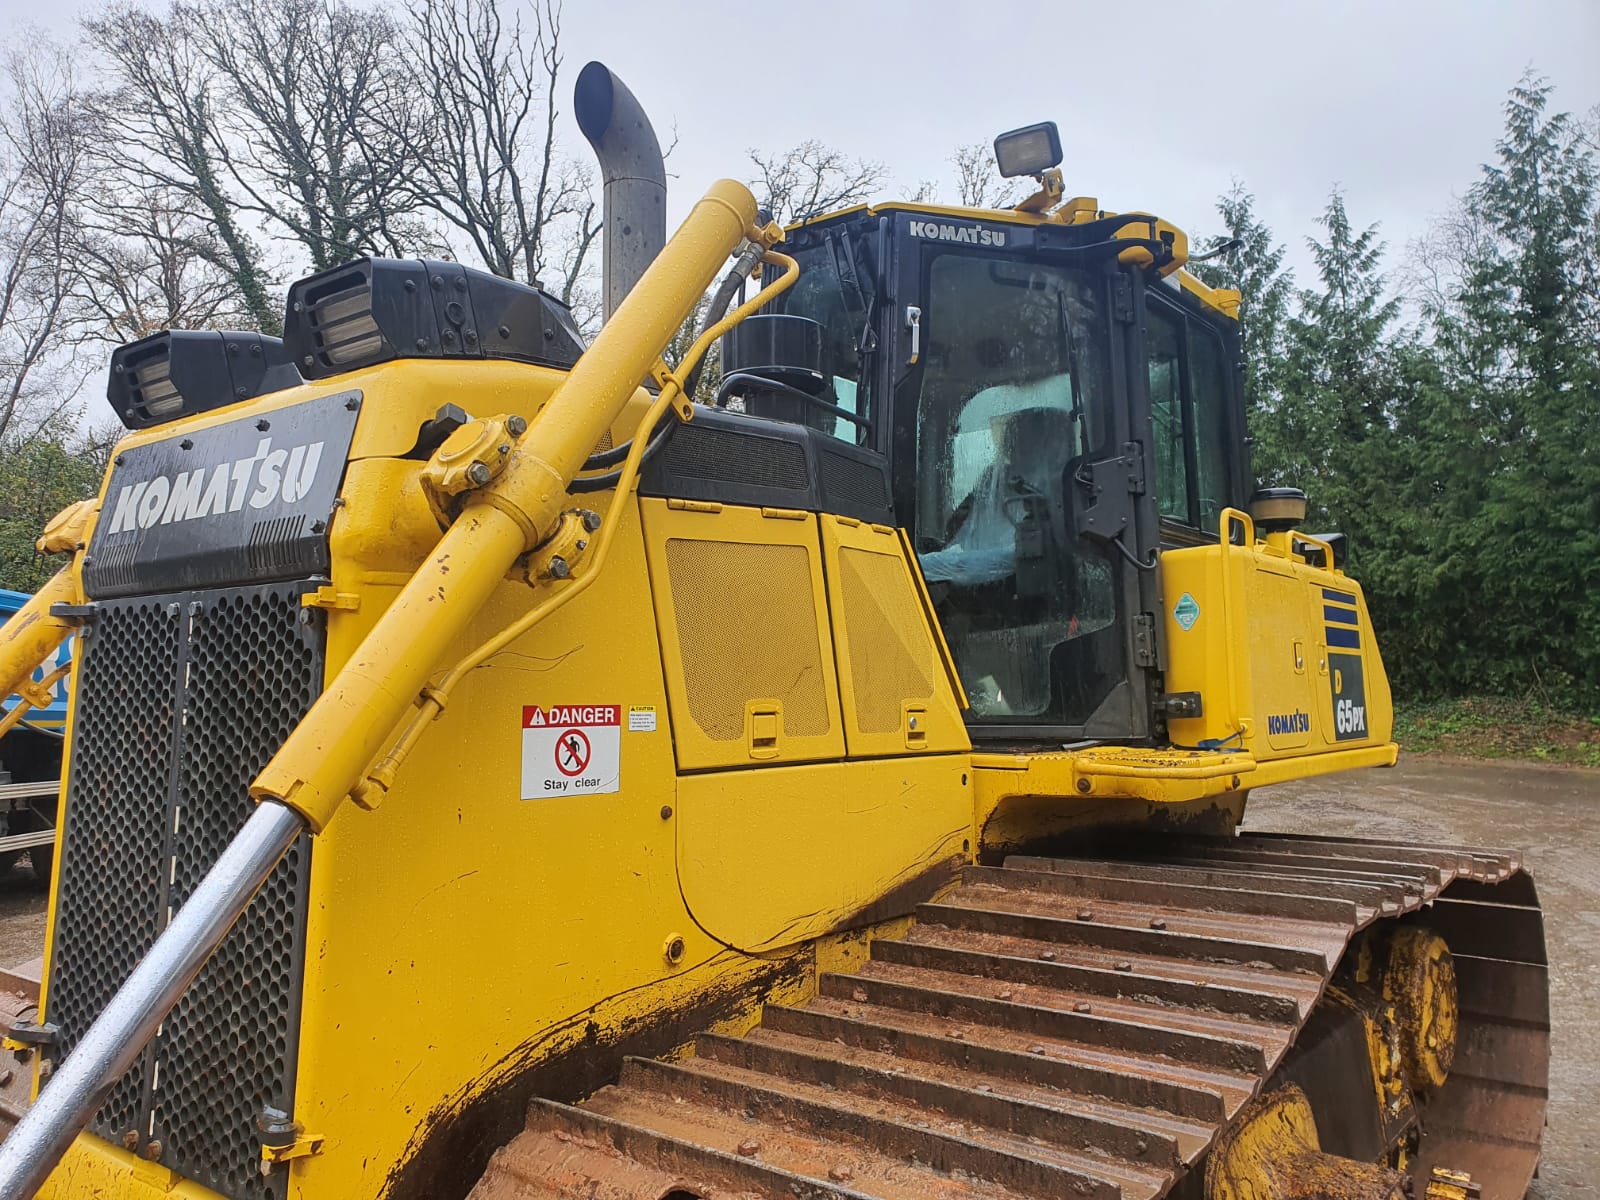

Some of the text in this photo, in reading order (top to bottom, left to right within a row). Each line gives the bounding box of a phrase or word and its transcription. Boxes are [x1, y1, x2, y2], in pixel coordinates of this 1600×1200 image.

[909, 221, 1006, 247] KOMATSU
[108, 437, 325, 535] KOMATSU
[1334, 669, 1343, 695] D
[549, 707, 615, 725] DANGER
[1267, 708, 1310, 735] KOMATSU
[543, 777, 601, 792] Stay clear
